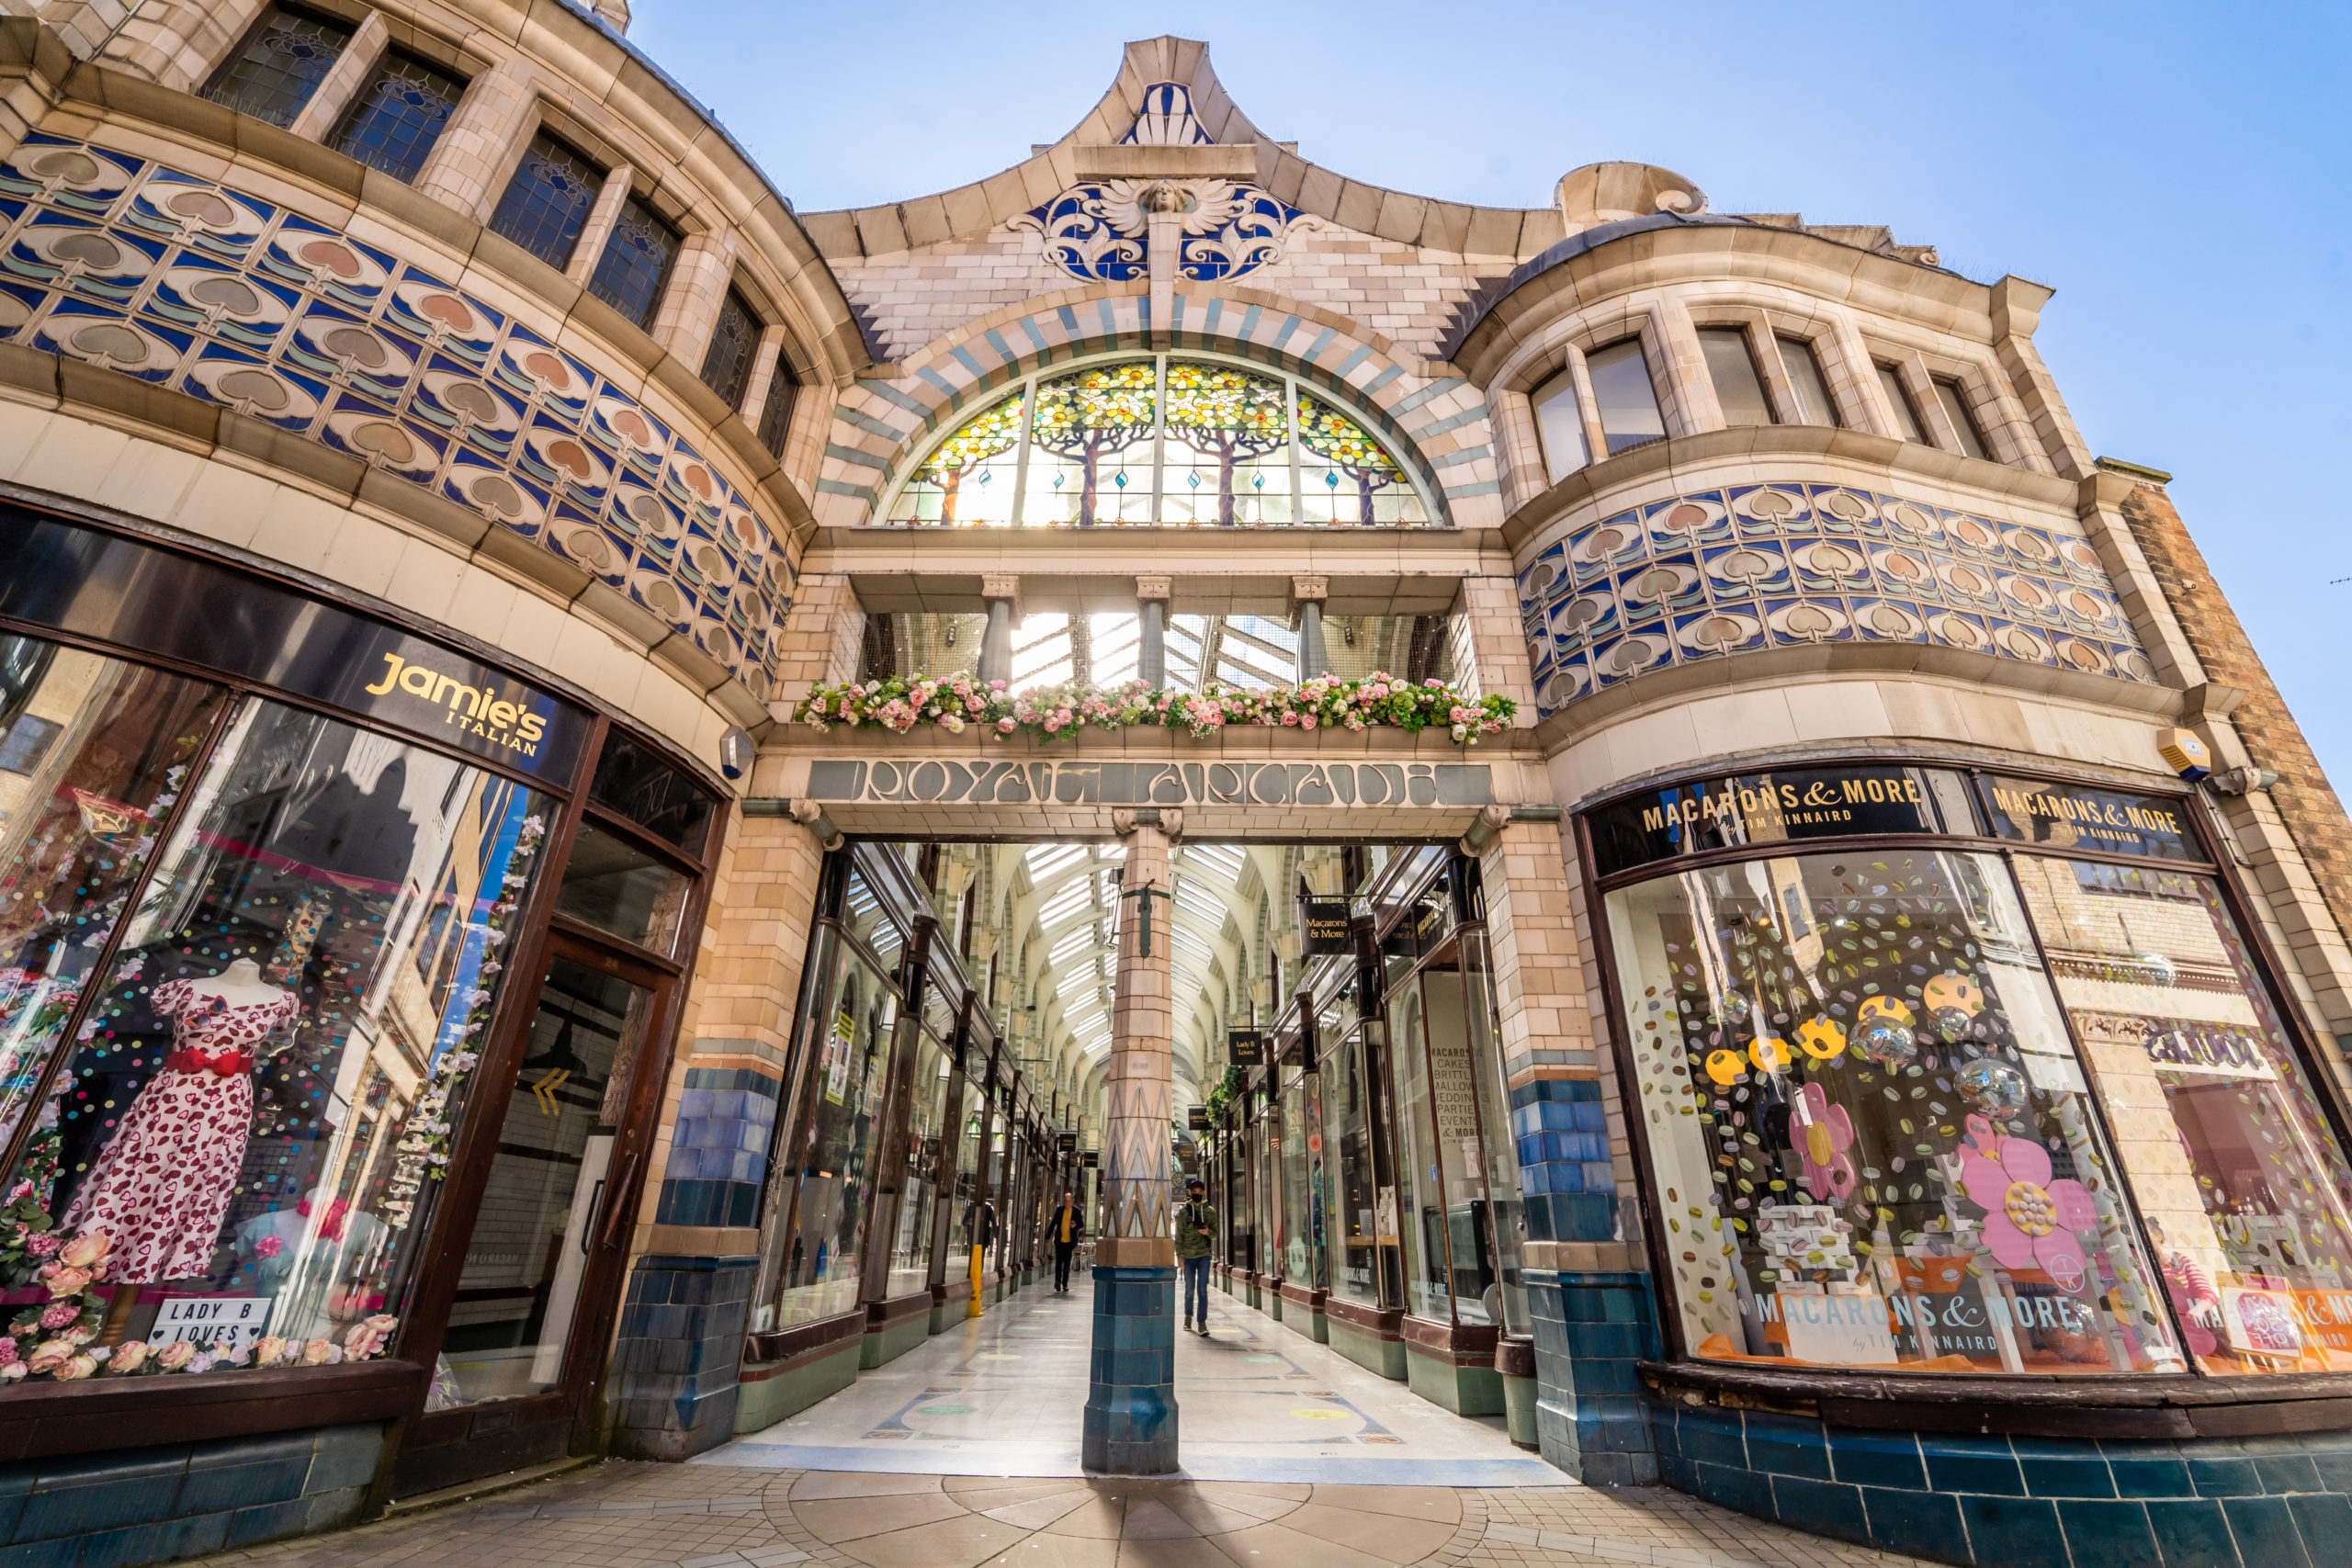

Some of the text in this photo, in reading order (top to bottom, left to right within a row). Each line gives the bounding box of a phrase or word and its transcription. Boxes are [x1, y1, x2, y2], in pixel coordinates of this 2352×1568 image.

[365, 652, 547, 742] Jamie's
[446, 711, 537, 757] ITALIAN
[859, 759, 1441, 807] ROYAL ARCADE
[1643, 779, 1922, 832] MACARONS & MORE
[1992, 787, 2182, 835] MACARONS & MORE
[1741, 816, 1766, 830] TIM
[1774, 809, 1852, 827] KINNAIRD
[2067, 824, 2086, 837] TIM
[2089, 828, 2140, 843] KINNAIRD
[1321, 929, 1345, 938] More
[1236, 1040, 1250, 1048] Lady
[1434, 1070, 1471, 1079] BRITTL
[1437, 1104, 1476, 1114] PARTIE
[2058, 1258, 2068, 1270] T
[2066, 1275, 2078, 1288] K
[170, 1303, 252, 1320] LADY B
[1755, 1293, 2077, 1328] MACARONS & MORE
[2306, 1295, 2334, 1325] &
[1869, 1334, 1900, 1348] TIM
[1910, 1335, 1997, 1350] KINNAIRD
